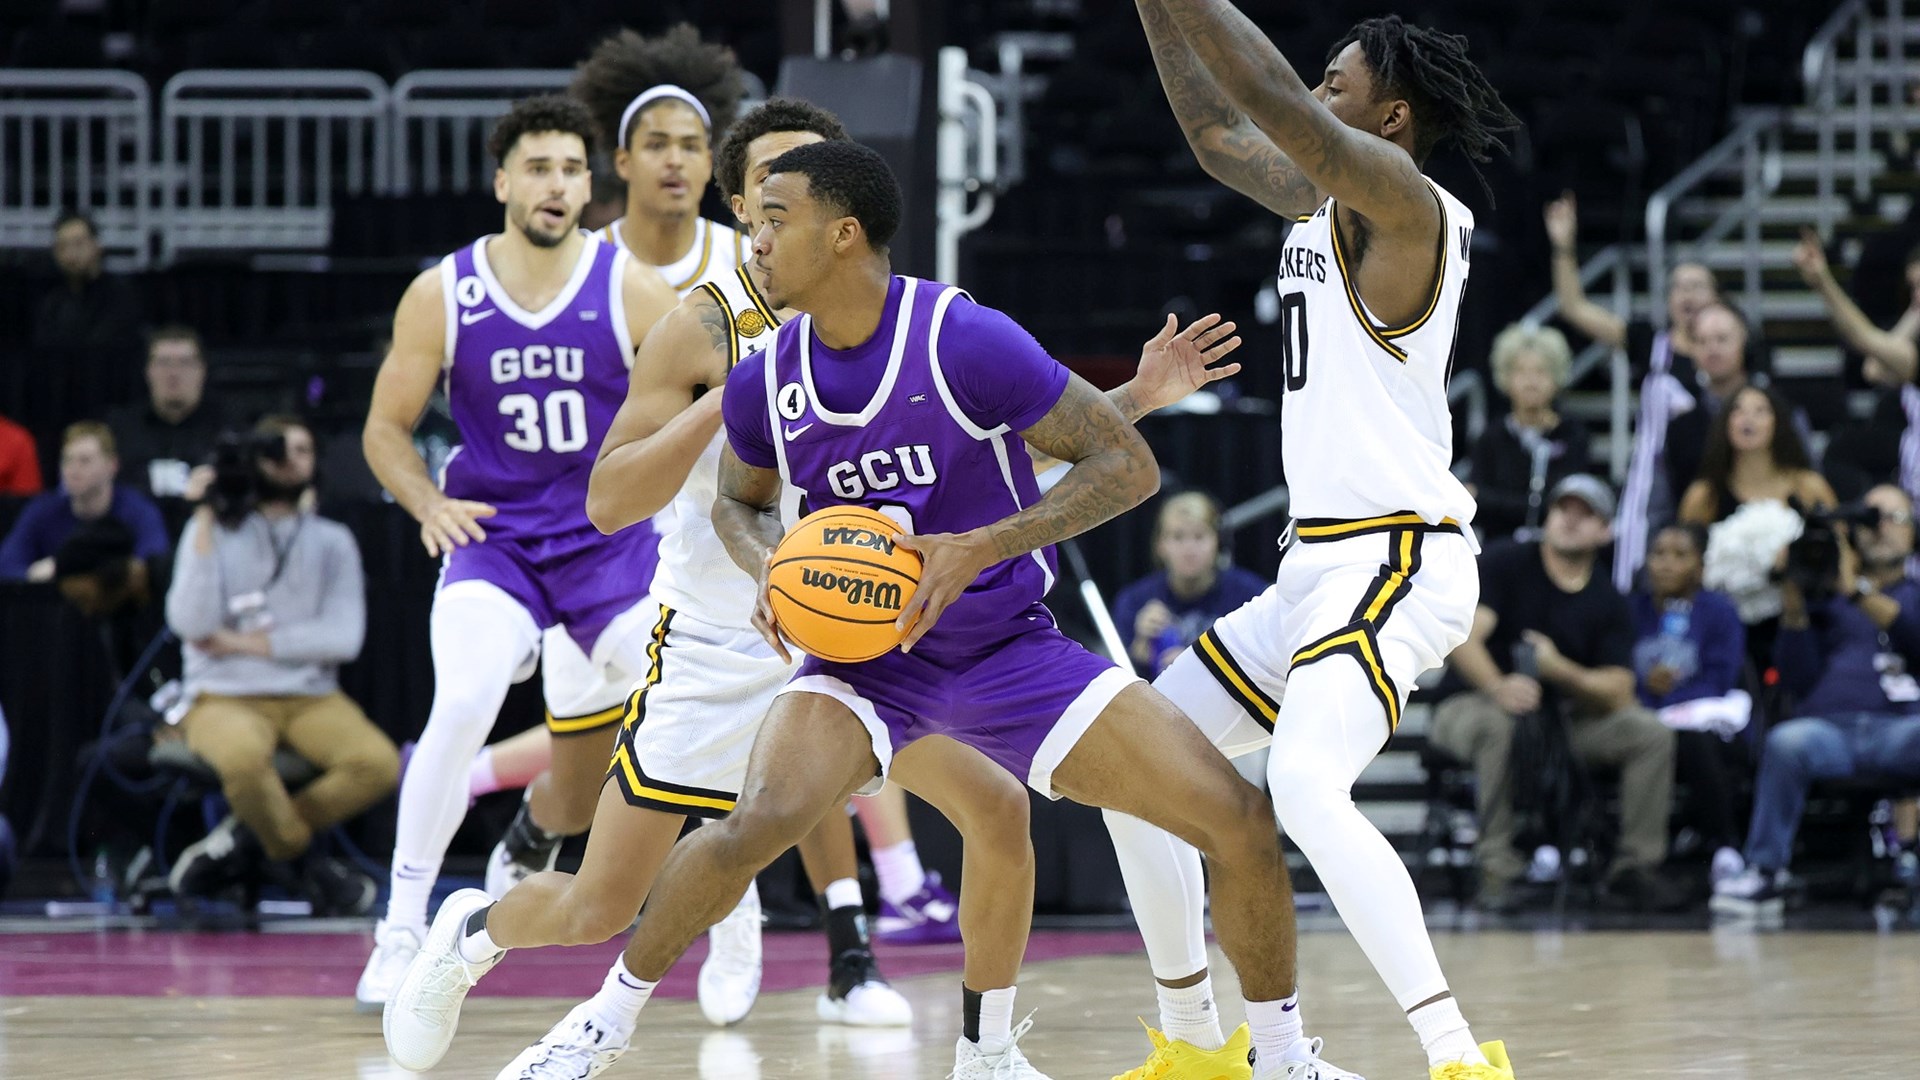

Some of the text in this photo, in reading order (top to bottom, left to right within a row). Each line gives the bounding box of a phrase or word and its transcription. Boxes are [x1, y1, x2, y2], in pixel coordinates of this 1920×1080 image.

[490, 344, 585, 384] GCU
[787, 388, 798, 413] 4
[909, 393, 926, 403] WAC
[498, 389, 588, 453] 30
[827, 445, 937, 499] GCU
[823, 527, 897, 556] NCAA
[802, 567, 901, 611] Wilson
